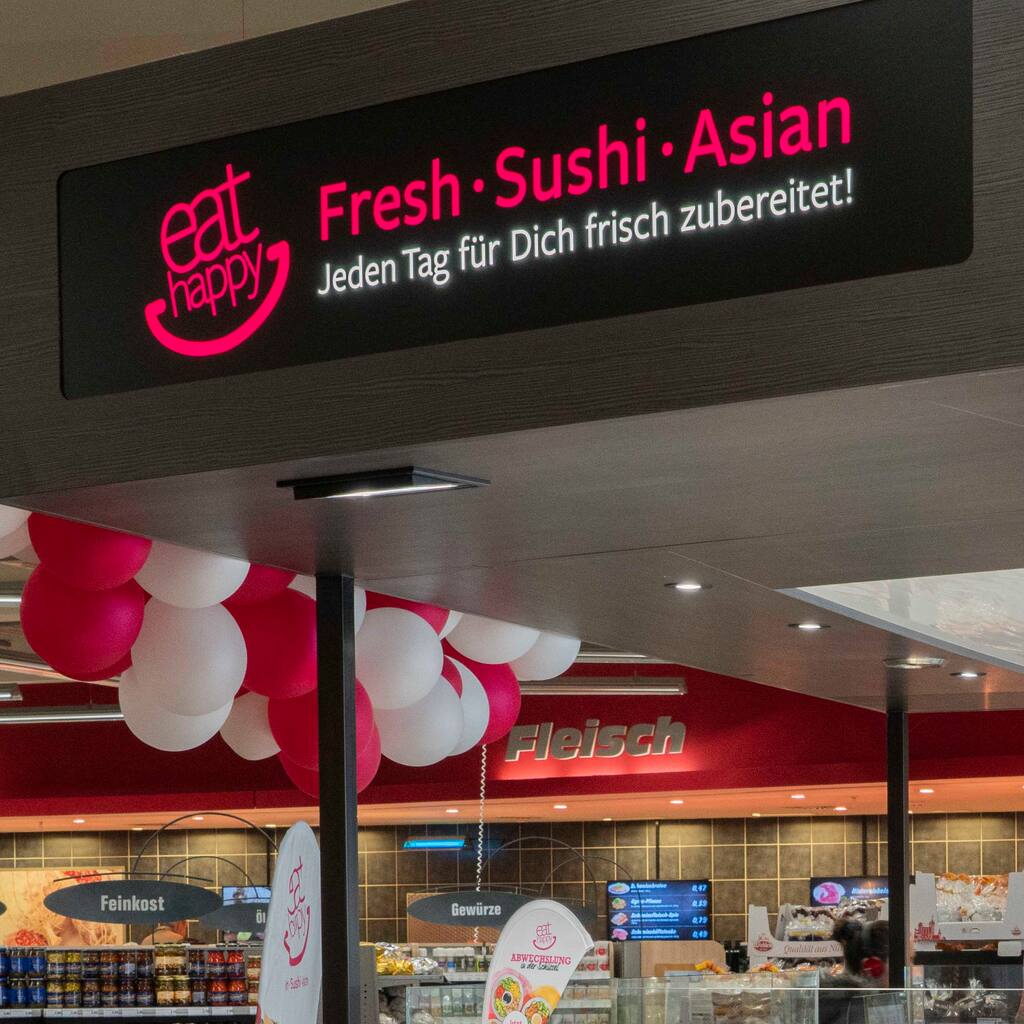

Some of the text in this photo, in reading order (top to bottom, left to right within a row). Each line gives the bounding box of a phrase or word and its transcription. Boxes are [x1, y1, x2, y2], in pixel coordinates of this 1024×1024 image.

[319, 91, 851, 242] Fresh Sushi Asian
[160, 163, 260, 275] eat
[317, 167, 854, 295] Jeden Tag für Dich frisch zubereitet!
[167, 242, 263, 319] happy
[504, 715, 687, 762] Fleisch
[100, 894, 165, 913] Feinkost
[451, 902, 502, 917] Gewürze
